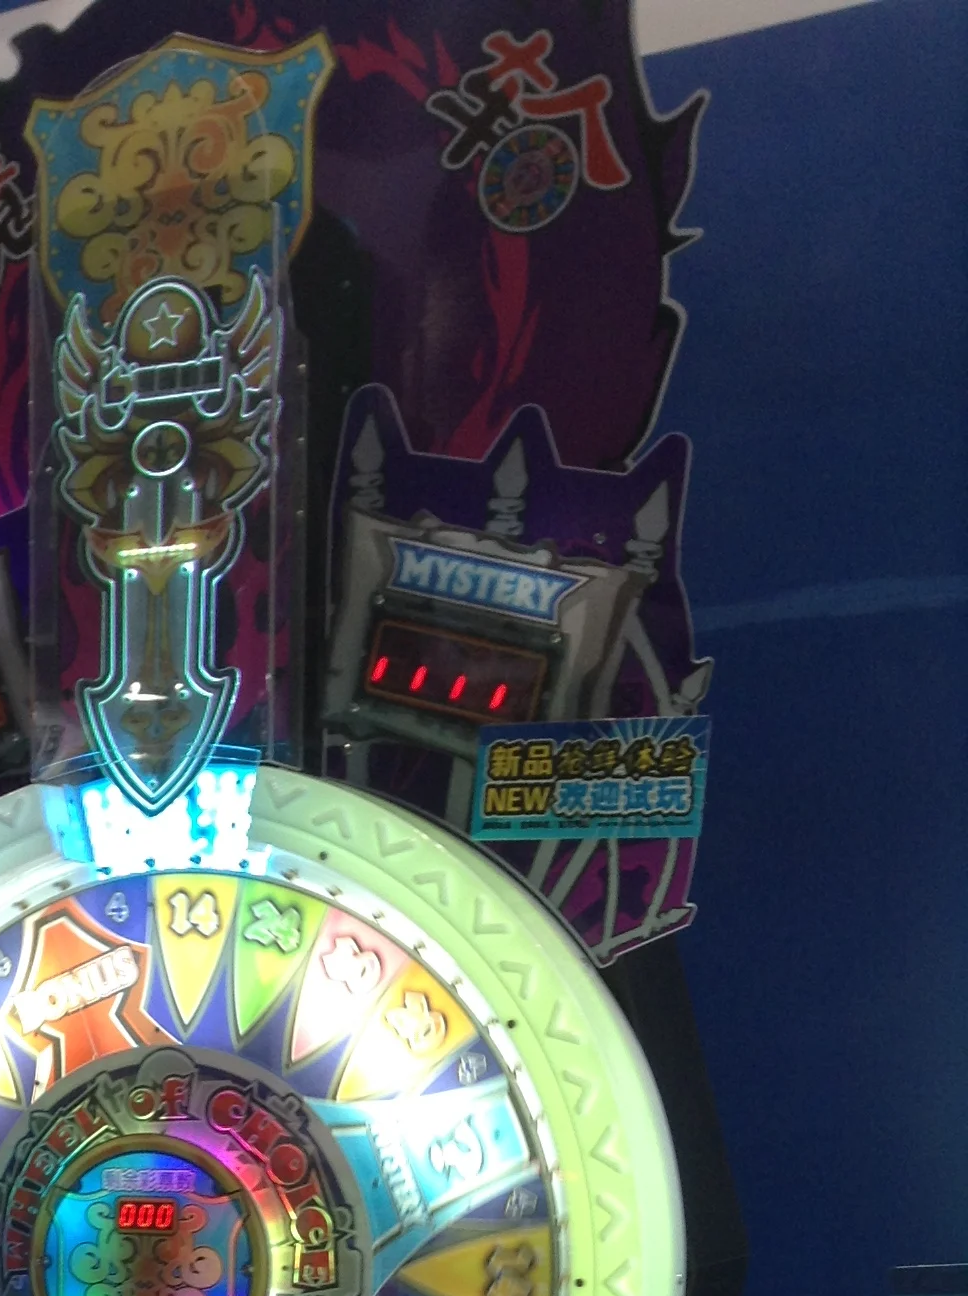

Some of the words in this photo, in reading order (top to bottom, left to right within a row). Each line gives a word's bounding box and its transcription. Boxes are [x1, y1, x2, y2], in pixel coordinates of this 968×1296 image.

[398, 549, 564, 614] MYSTERY
[486, 785, 551, 814] NEW
[168, 888, 222, 938] 14
[5, 1098, 116, 1273] WHEEL
[129, 1075, 202, 1123] of
[207, 1089, 337, 1288] CHOICE
[119, 1204, 174, 1228] 000
